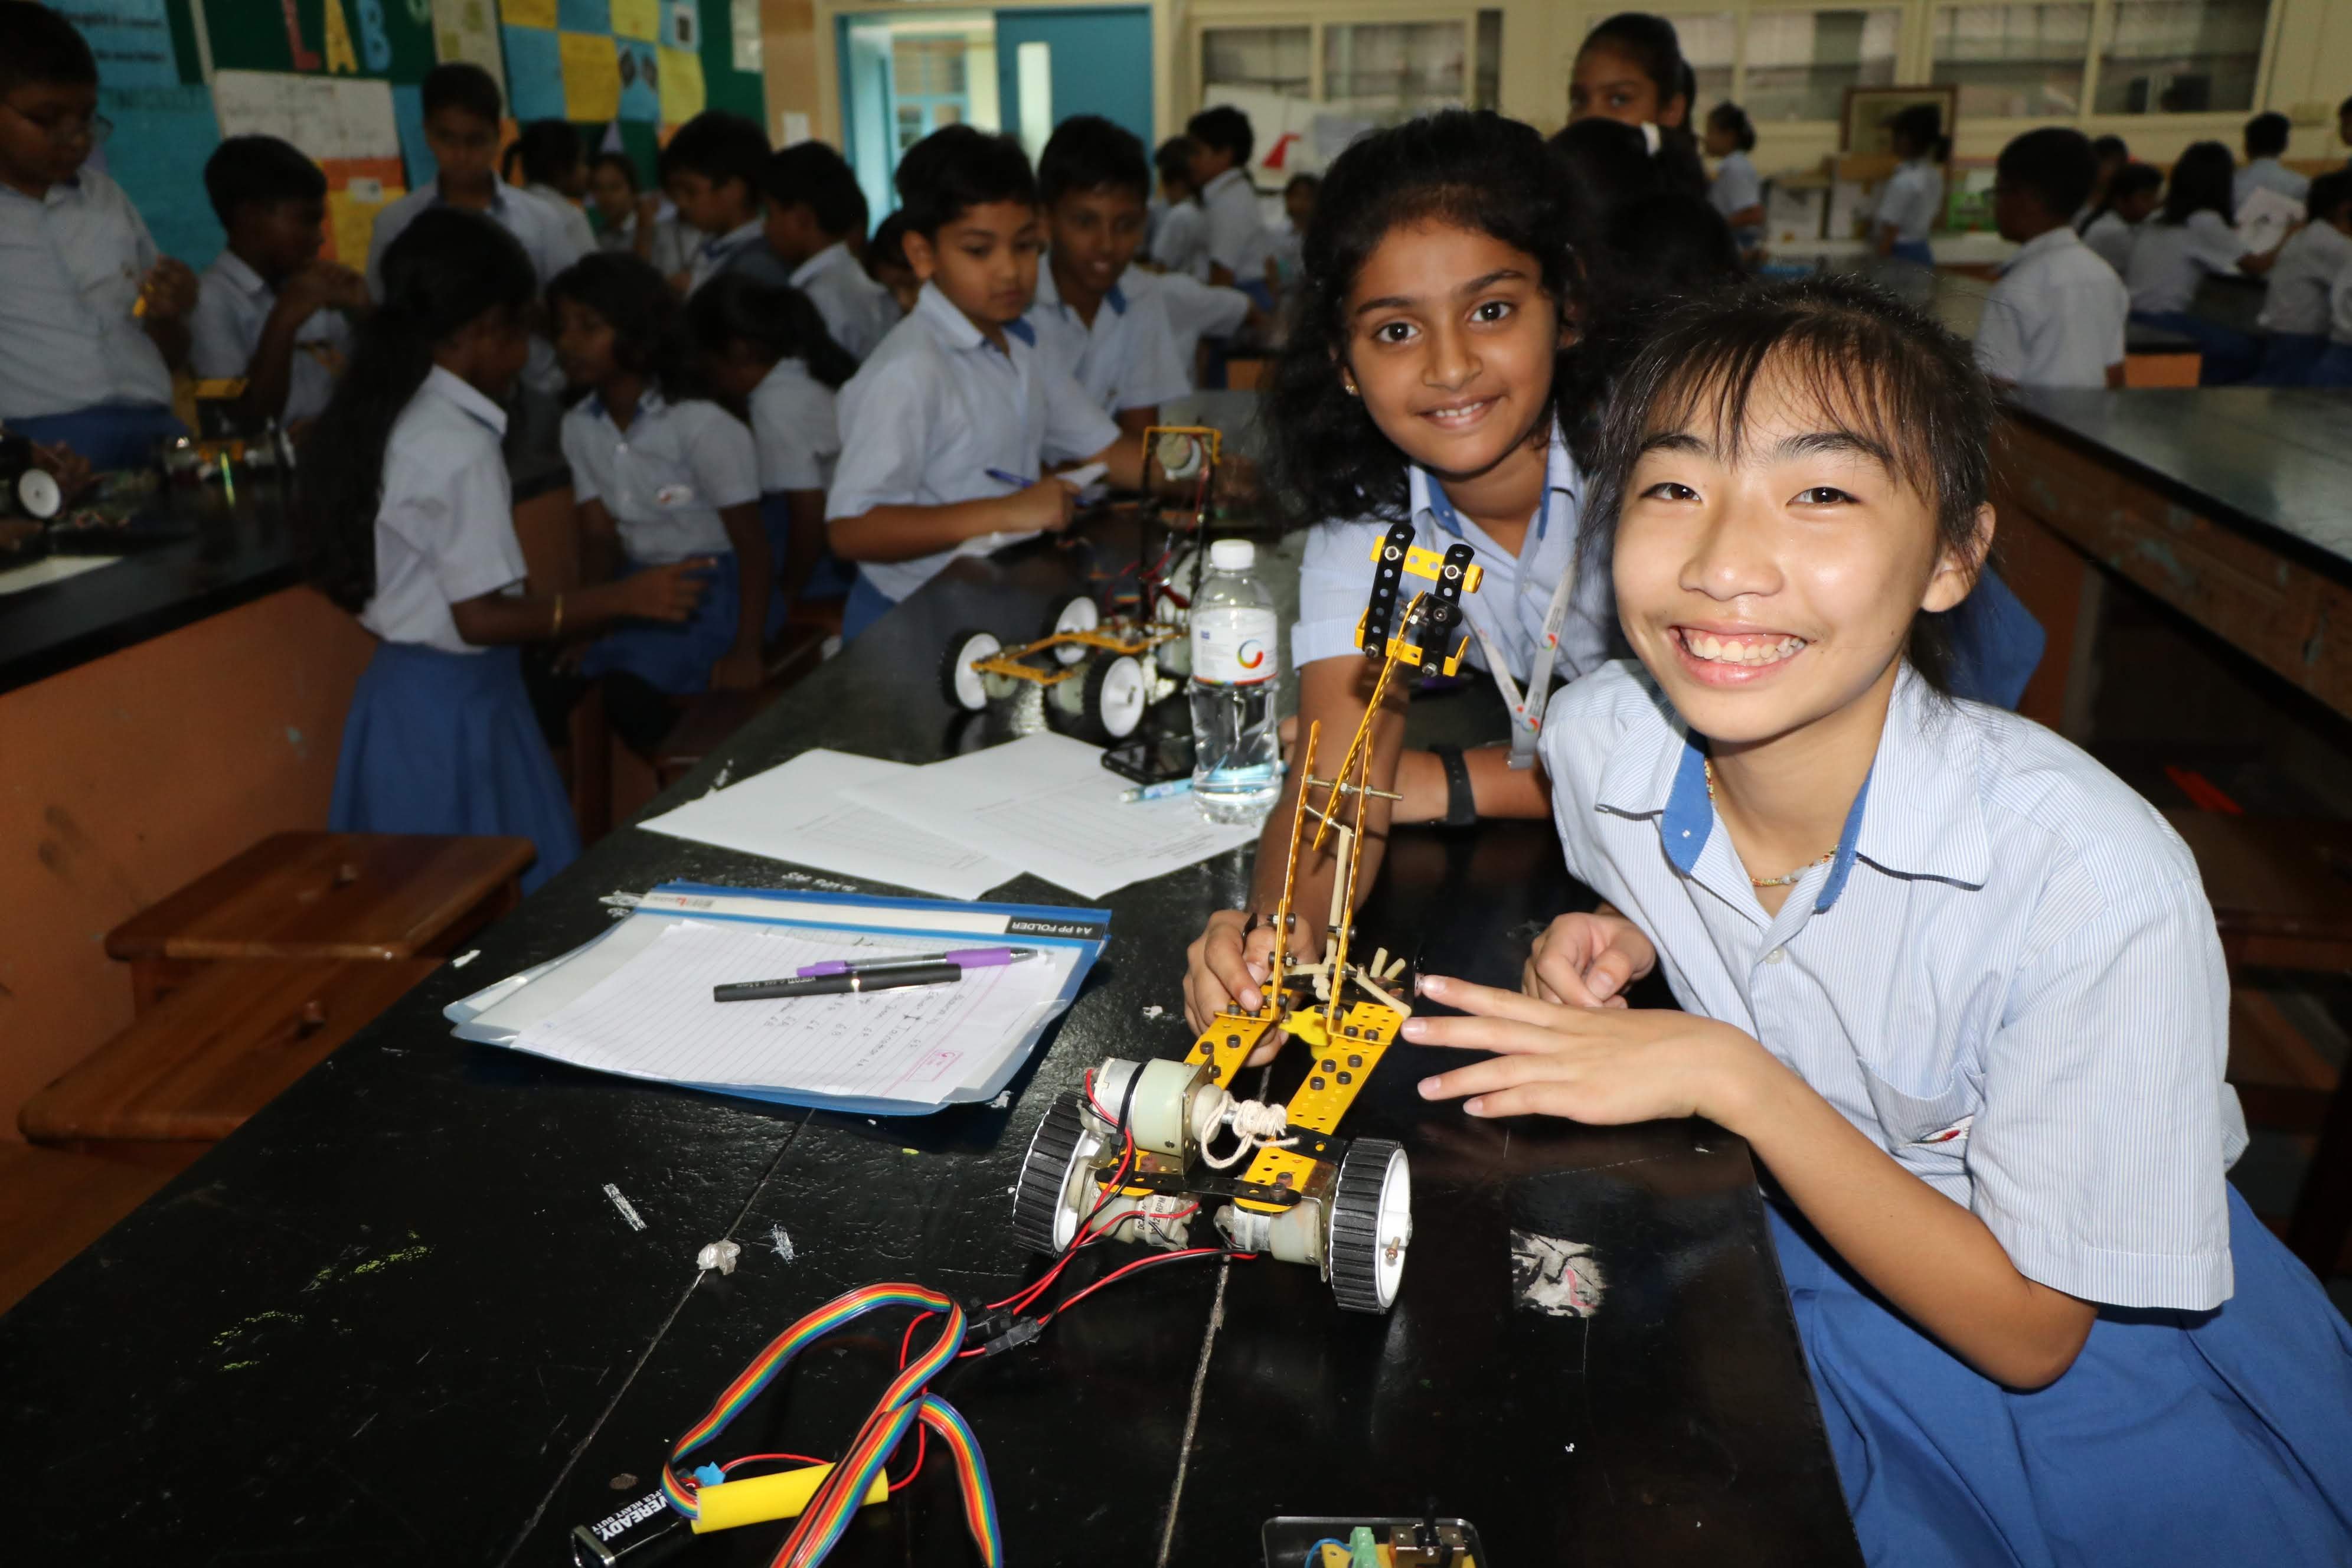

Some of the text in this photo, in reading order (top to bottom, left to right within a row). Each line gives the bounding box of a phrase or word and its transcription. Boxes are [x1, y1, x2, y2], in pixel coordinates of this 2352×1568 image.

[1011, 921, 1092, 935] A4 PP FOLDER
[1155, 1197, 1167, 1213] RPM
[591, 1488, 662, 1533] PER HEAVY DUTY
[603, 1495, 669, 1541] VEREADY
